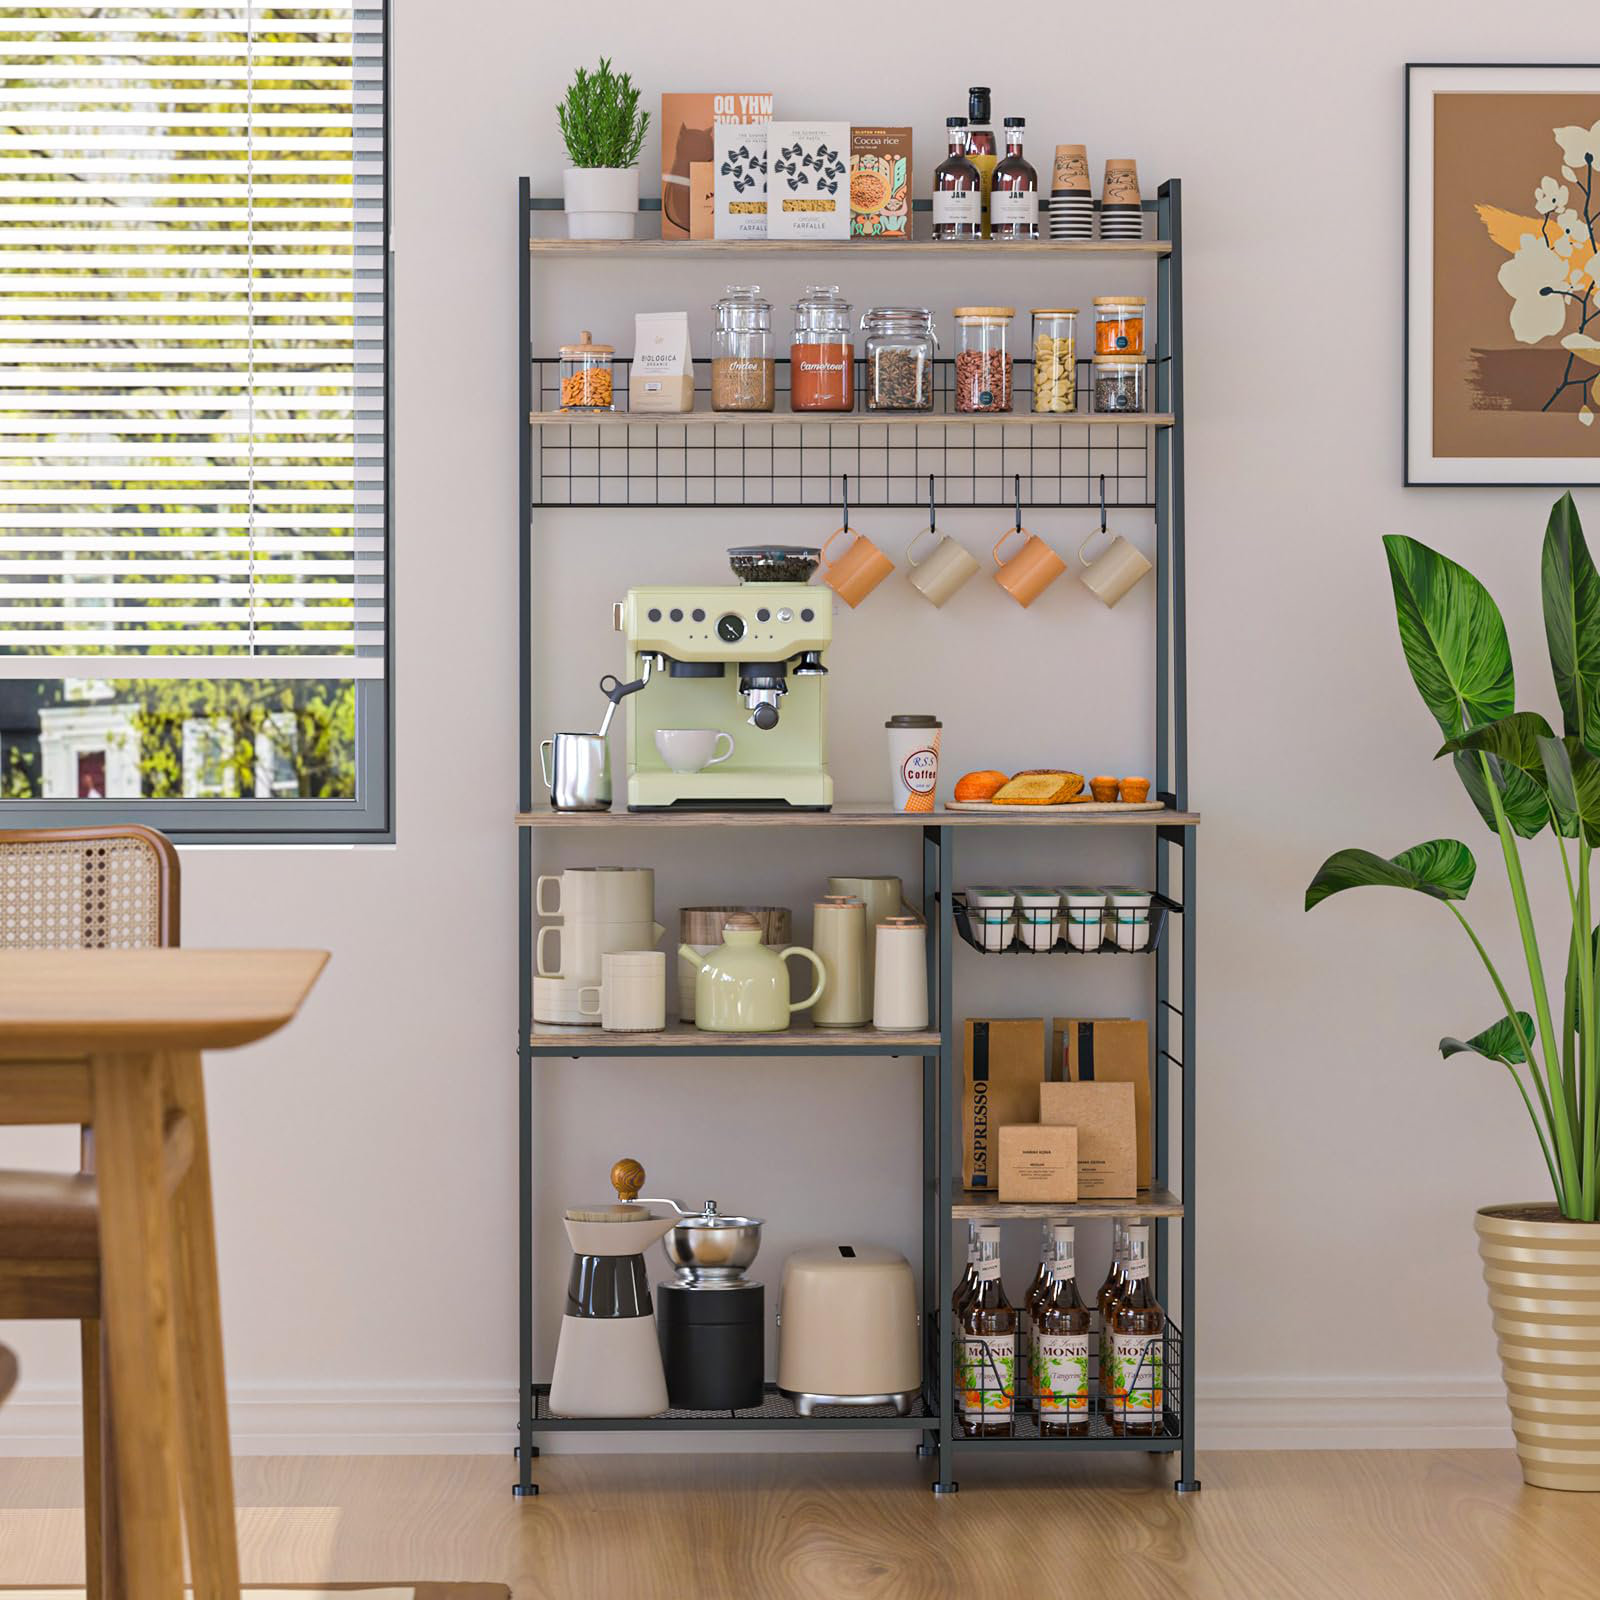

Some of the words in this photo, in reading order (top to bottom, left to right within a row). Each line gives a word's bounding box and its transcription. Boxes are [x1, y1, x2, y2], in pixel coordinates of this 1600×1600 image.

[854, 136, 881, 145] Cocoa
[883, 136, 900, 145] rice
[951, 191, 966, 199] JAM
[1009, 191, 1024, 199] JAM
[739, 224, 768, 232] FARFALL
[793, 222, 825, 230] FARFALLE
[641, 354, 677, 362] BIOLOGICA
[974, 1082, 988, 1174] ESPRESSO
[1043, 1346, 1088, 1357] MONIN
